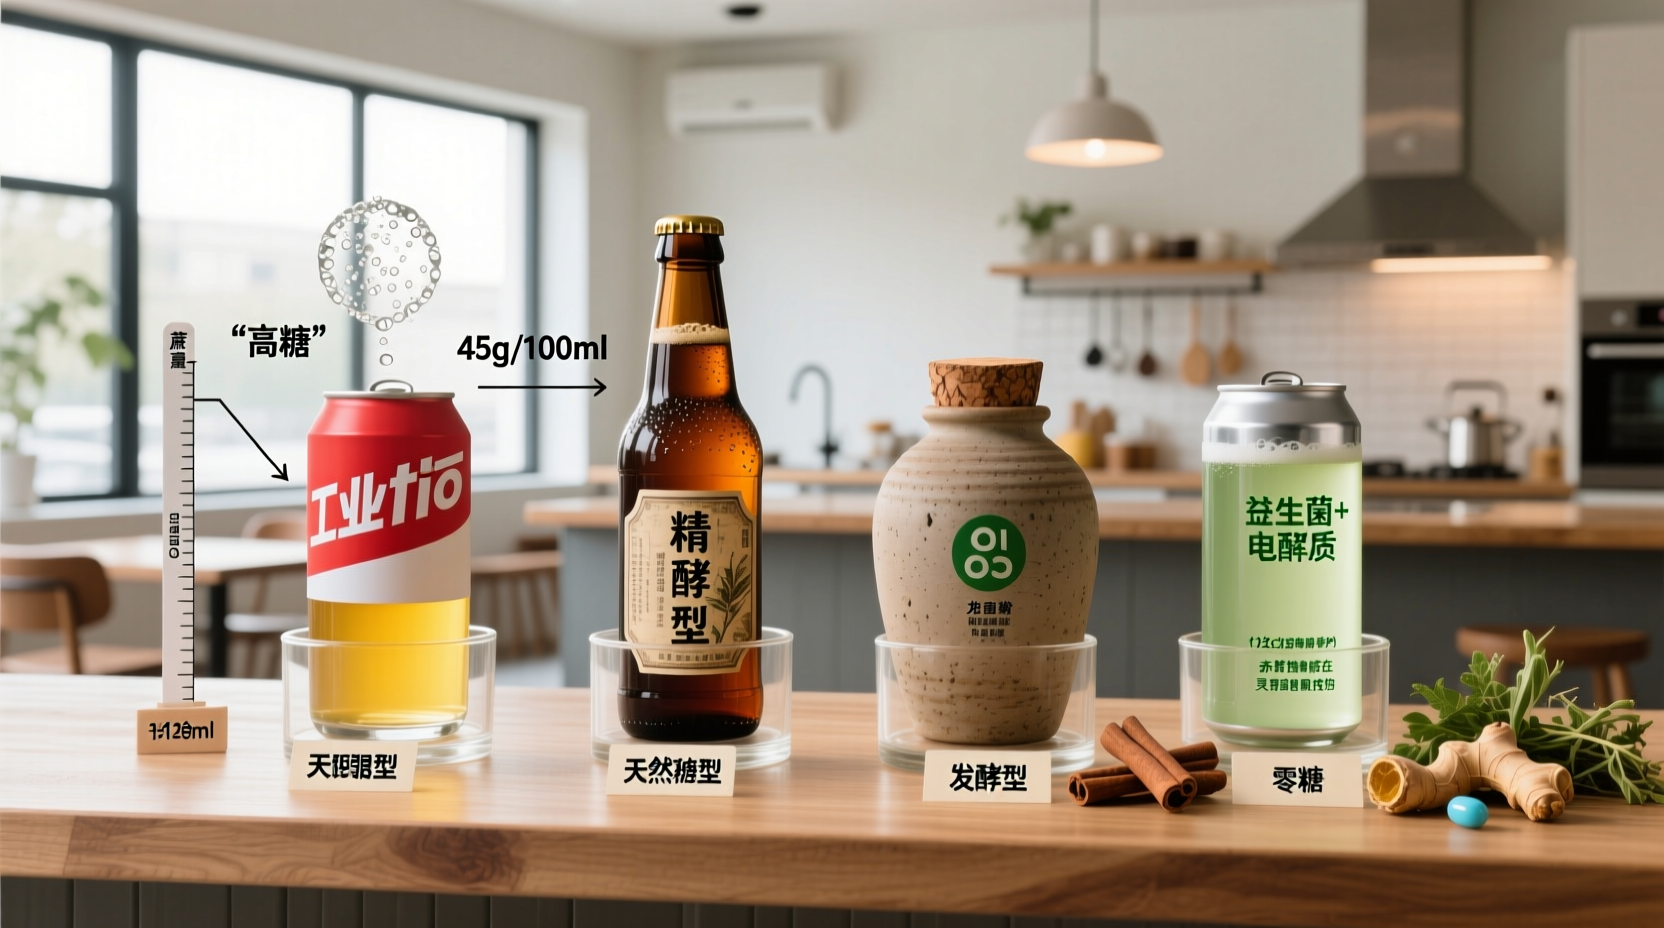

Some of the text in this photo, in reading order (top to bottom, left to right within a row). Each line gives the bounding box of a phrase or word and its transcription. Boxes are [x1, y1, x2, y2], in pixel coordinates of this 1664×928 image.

[1246, 495, 1349, 526] 益生菌+
[670, 511, 711, 644] 精酵型
[949, 762, 1027, 792] 发酵型
[1273, 765, 1324, 794] 零糖
